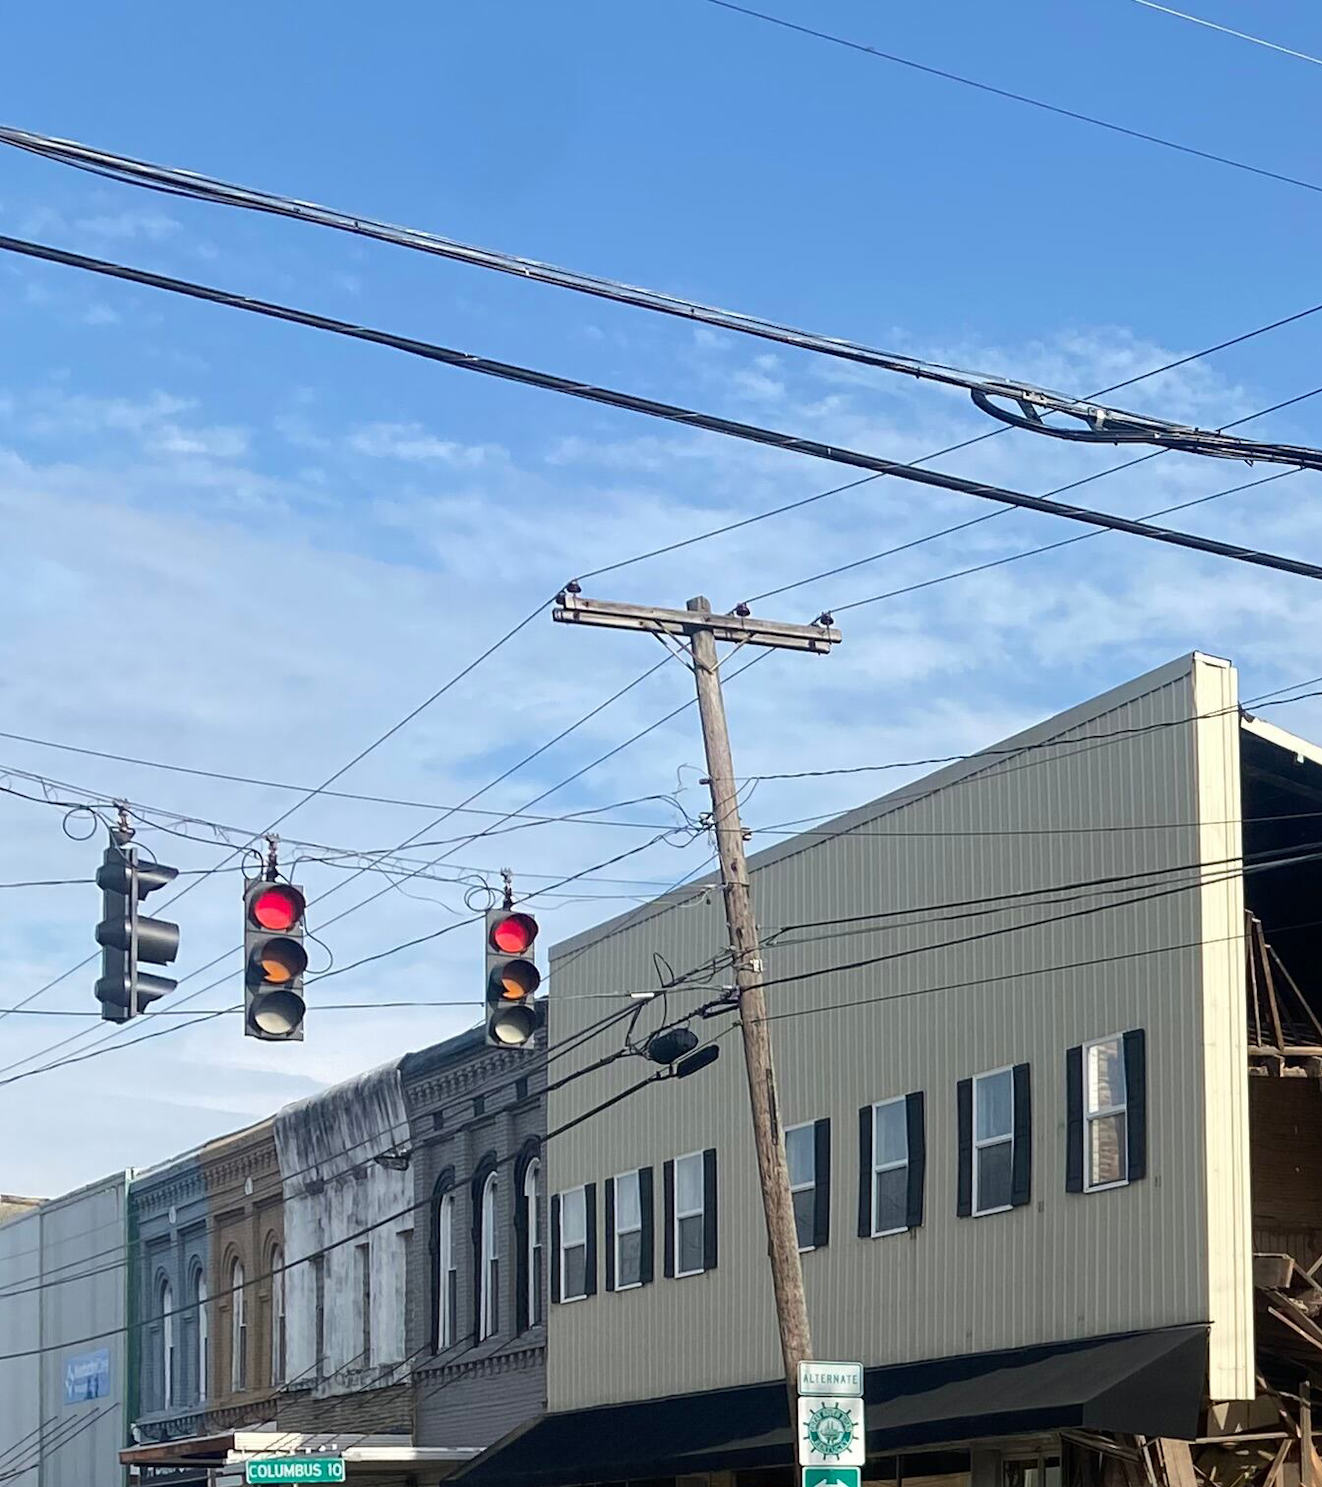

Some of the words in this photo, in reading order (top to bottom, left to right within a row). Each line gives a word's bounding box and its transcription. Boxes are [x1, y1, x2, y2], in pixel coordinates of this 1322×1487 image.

[803, 1374, 858, 1384] ALTERNATE
[250, 1462, 322, 1478] COLUMBUS
[327, 1462, 343, 1477] 10
